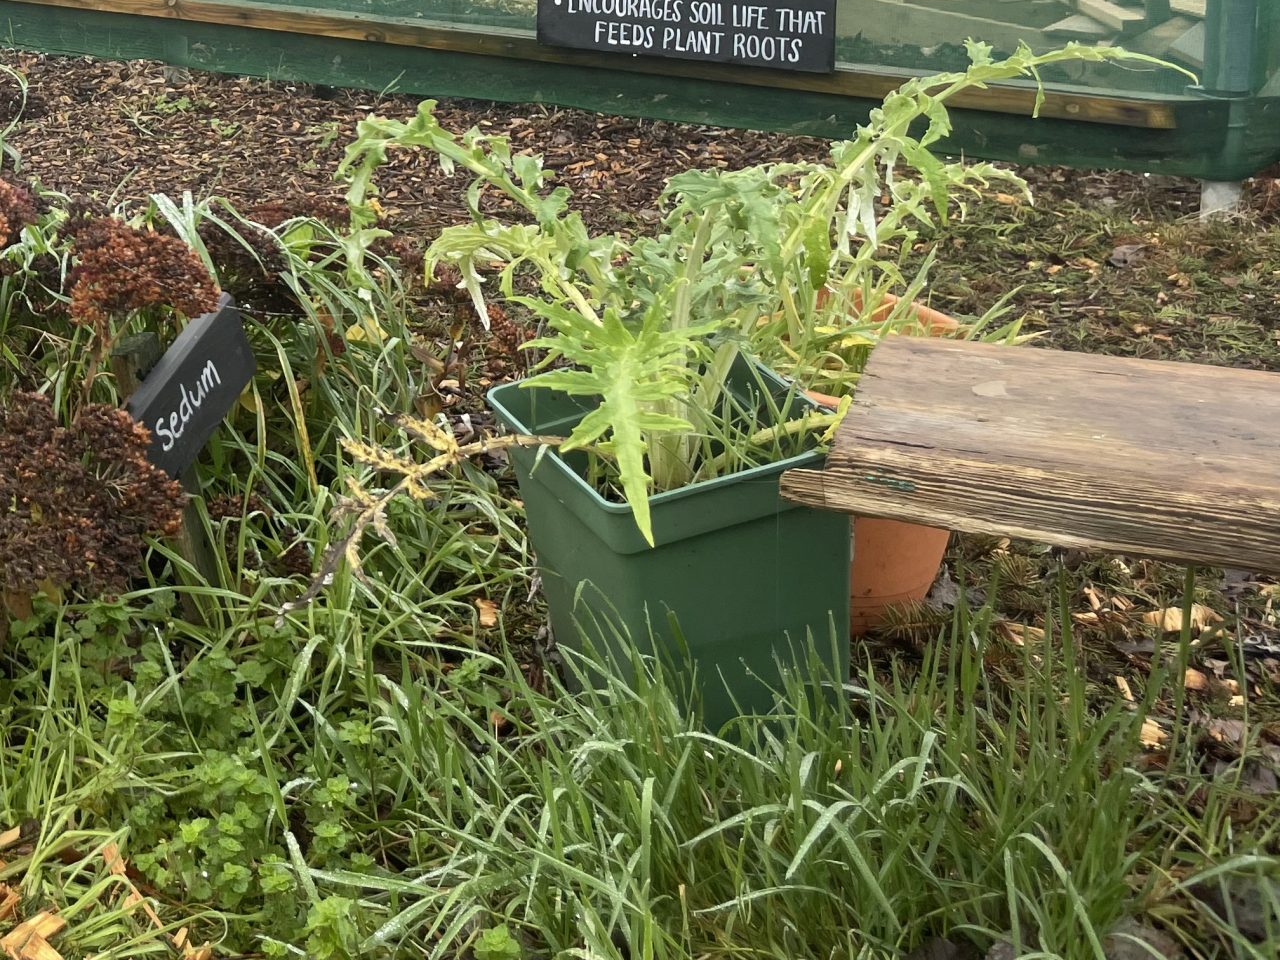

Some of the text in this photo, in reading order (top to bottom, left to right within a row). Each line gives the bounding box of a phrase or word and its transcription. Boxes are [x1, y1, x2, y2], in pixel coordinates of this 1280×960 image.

[688, 0, 725, 26] SOIL
[732, 4, 769, 30] LIFE
[775, 8, 826, 35] THAT
[594, 20, 803, 63] FEEDS PLANT ROOTS
[155, 359, 222, 452] Sedum
